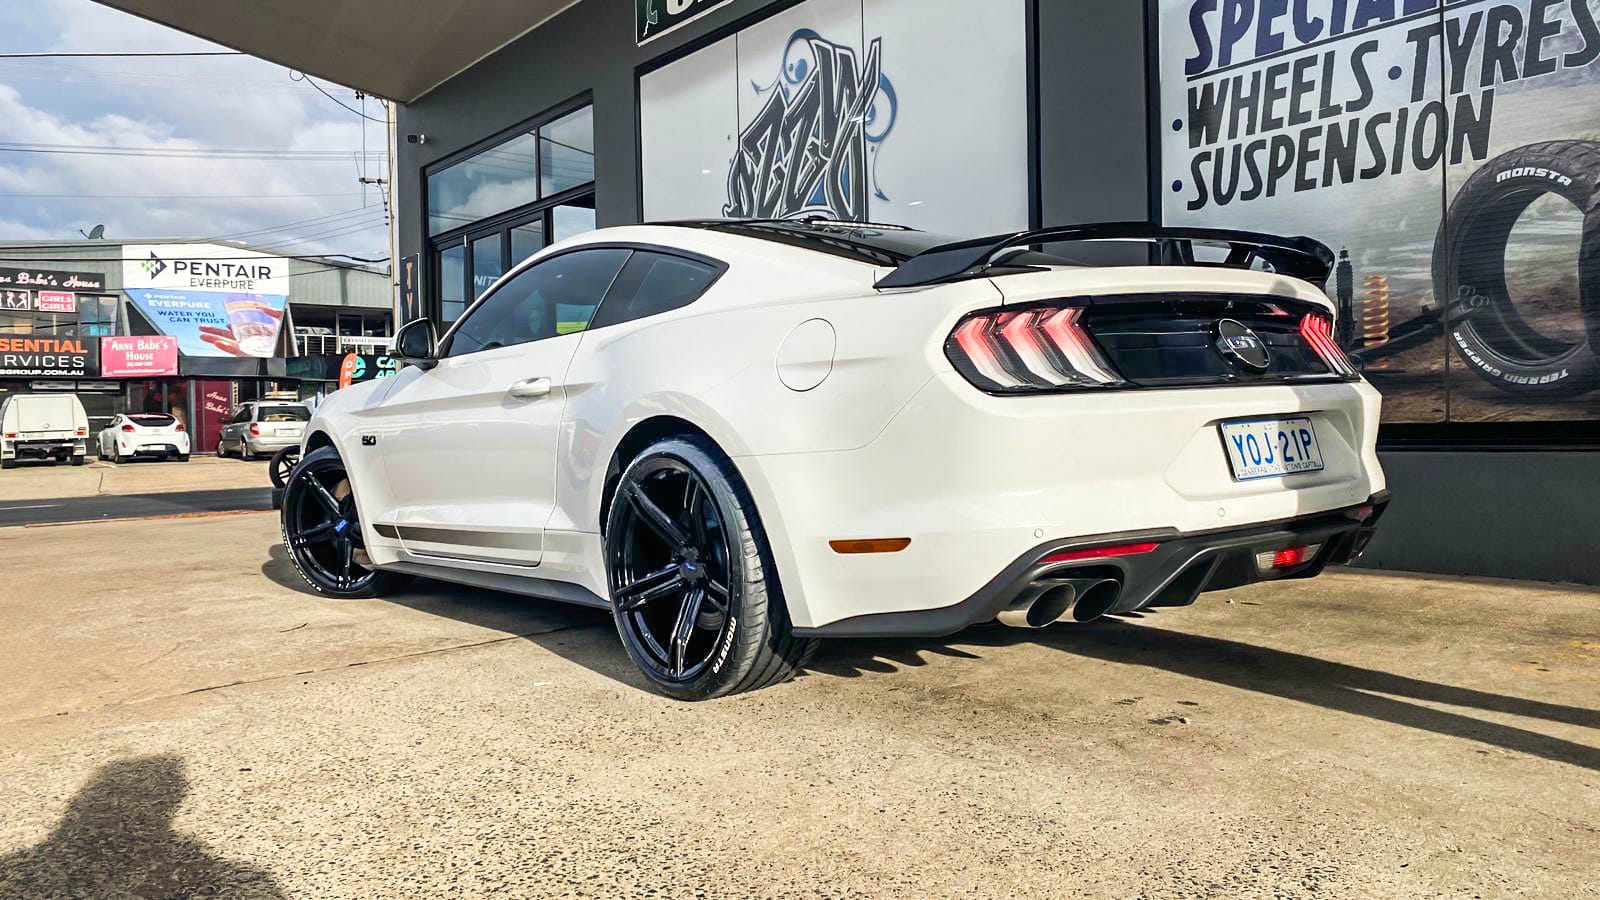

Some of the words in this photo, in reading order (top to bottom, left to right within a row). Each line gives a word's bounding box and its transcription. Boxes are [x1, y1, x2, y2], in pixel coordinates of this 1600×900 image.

[1187, 39, 1379, 150] WHEELS
[1406, 0, 1600, 103] TYRES
[1187, 88, 1495, 211] SUSPENSION
[1496, 166, 1573, 187] MONSTA
[174, 261, 271, 280] PENTAIR
[190, 277, 254, 290] EVERPURE
[148, 300, 213, 309] EVERPURE
[157, 310, 193, 318] WATER
[0, 338, 88, 353] SENTIAL
[1453, 332, 1501, 377] GRIPPER
[4, 354, 85, 368] RVICES
[712, 616, 737, 675] MONSTA
